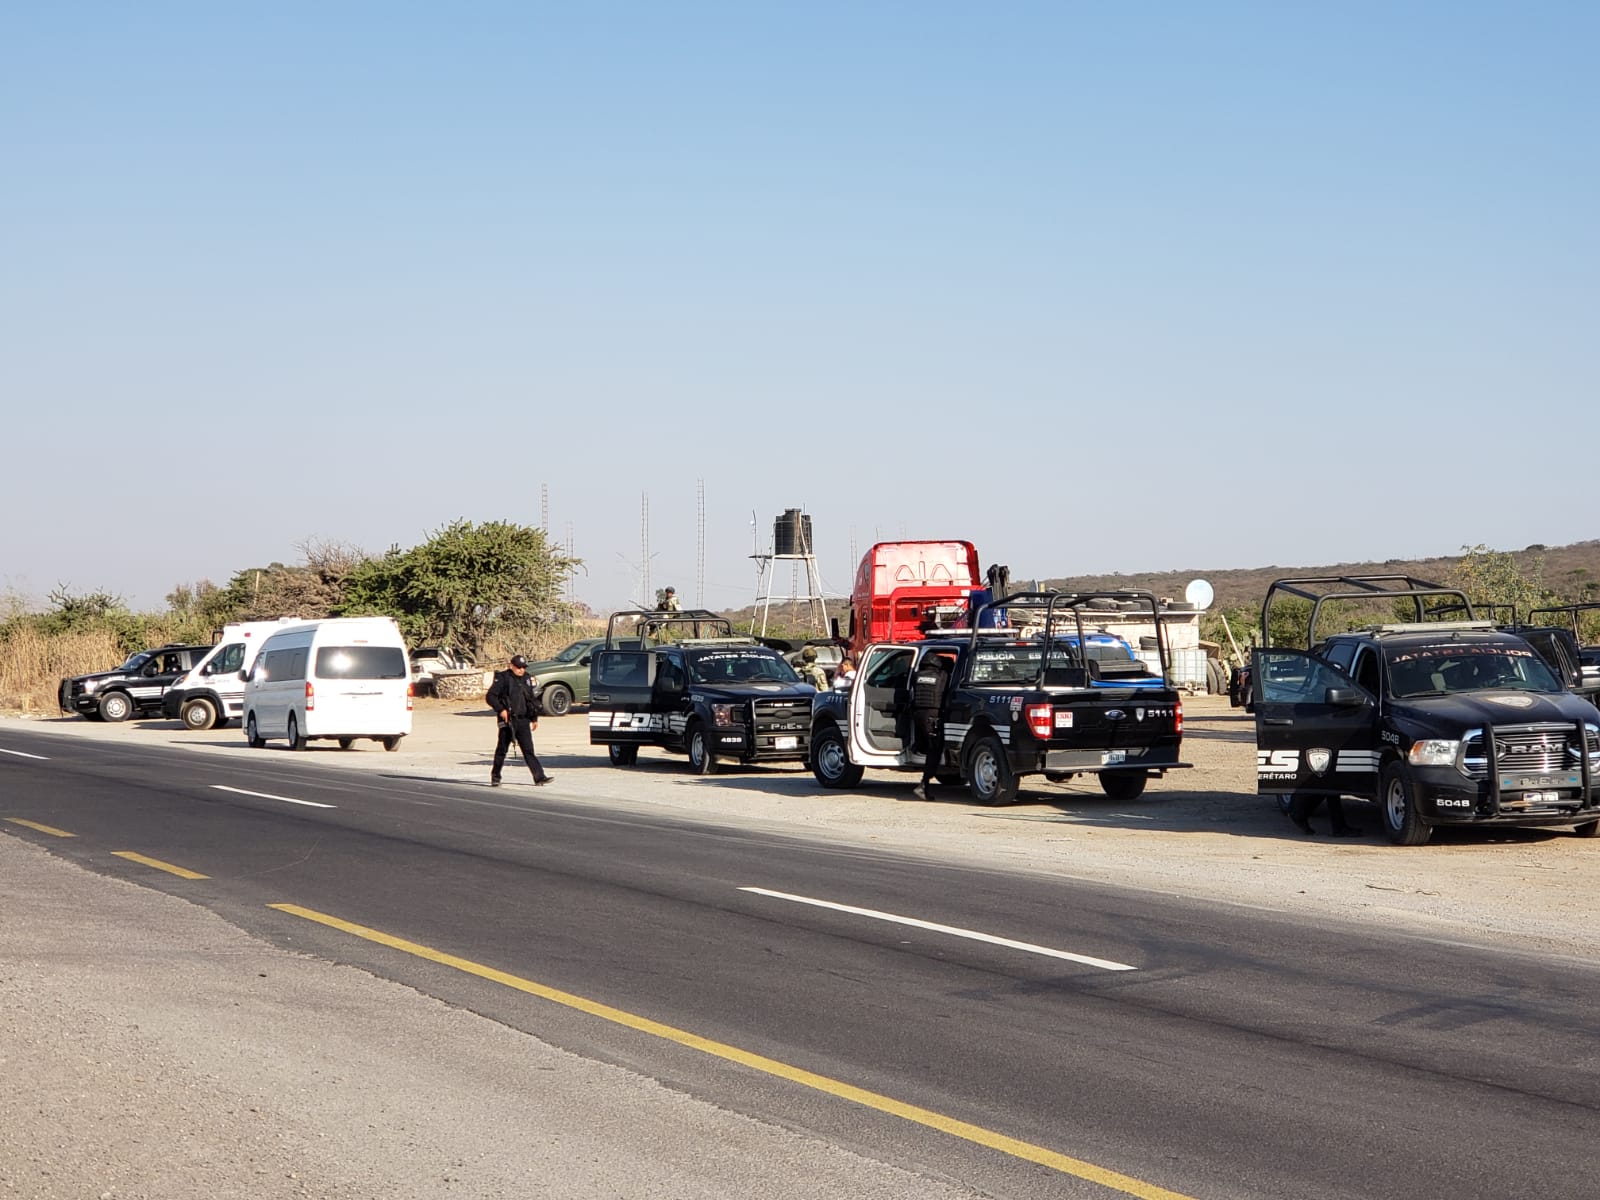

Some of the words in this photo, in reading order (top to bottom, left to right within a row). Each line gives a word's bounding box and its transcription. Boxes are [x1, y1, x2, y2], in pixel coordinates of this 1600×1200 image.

[1028, 652, 1070, 660] ESATAL
[989, 695, 1011, 704] 5111
[1147, 709, 1174, 718] 5111
[1511, 743, 1564, 753] RAM
[1436, 799, 1470, 807] 5048
